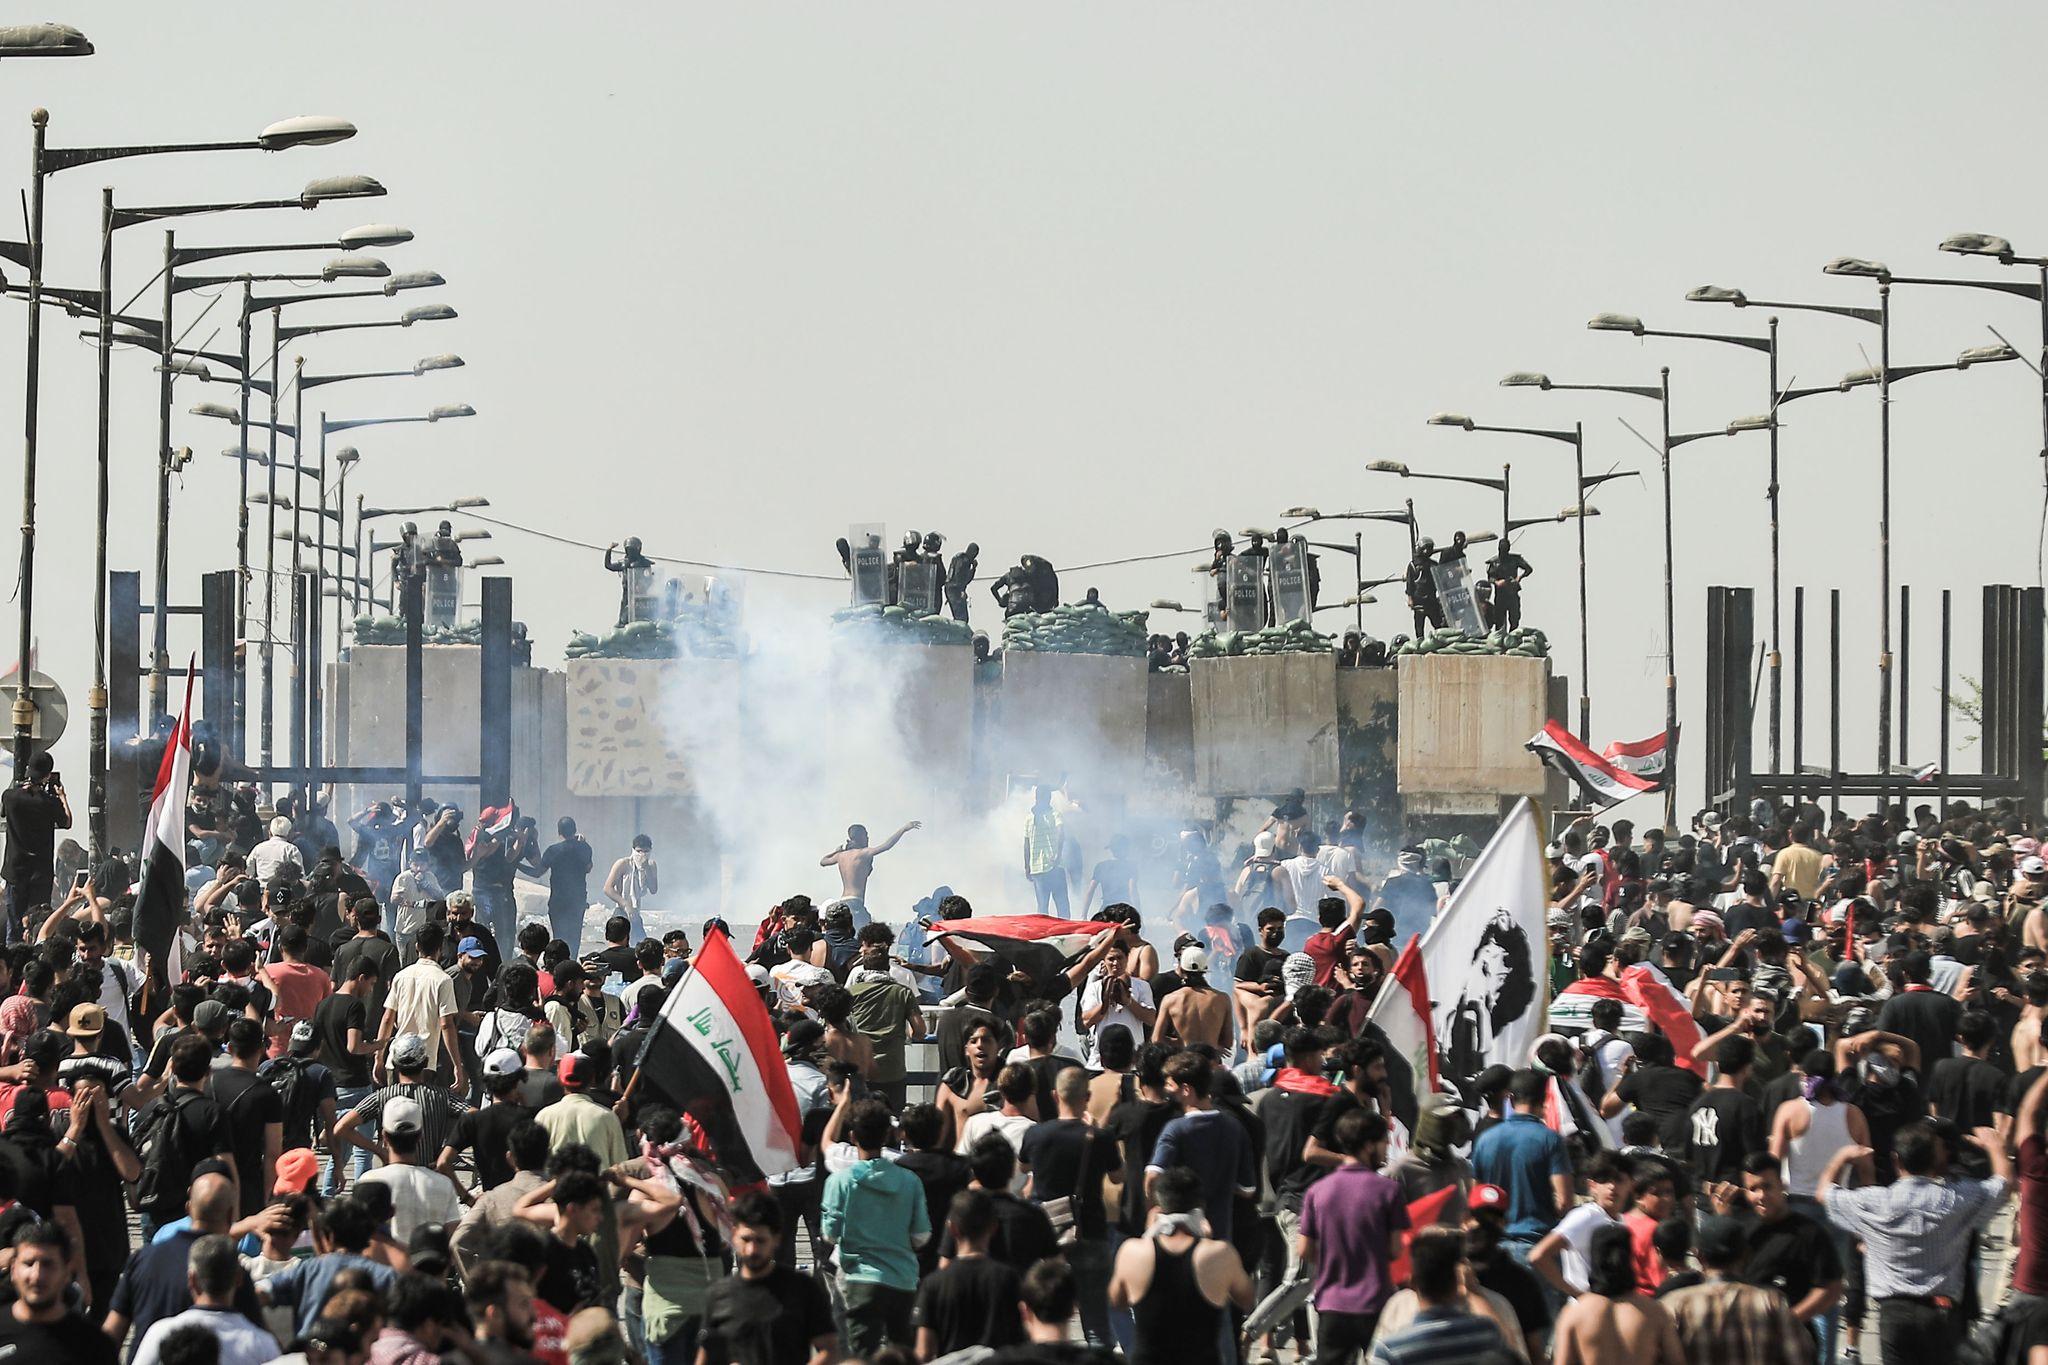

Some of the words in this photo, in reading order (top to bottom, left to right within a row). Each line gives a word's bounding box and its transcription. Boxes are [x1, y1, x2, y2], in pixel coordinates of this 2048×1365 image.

[857, 556, 880, 566] POLICE
[1279, 576, 1303, 586] POLICE
[1234, 589, 1256, 598] POLICE
[1691, 1107, 1719, 1146] NY
